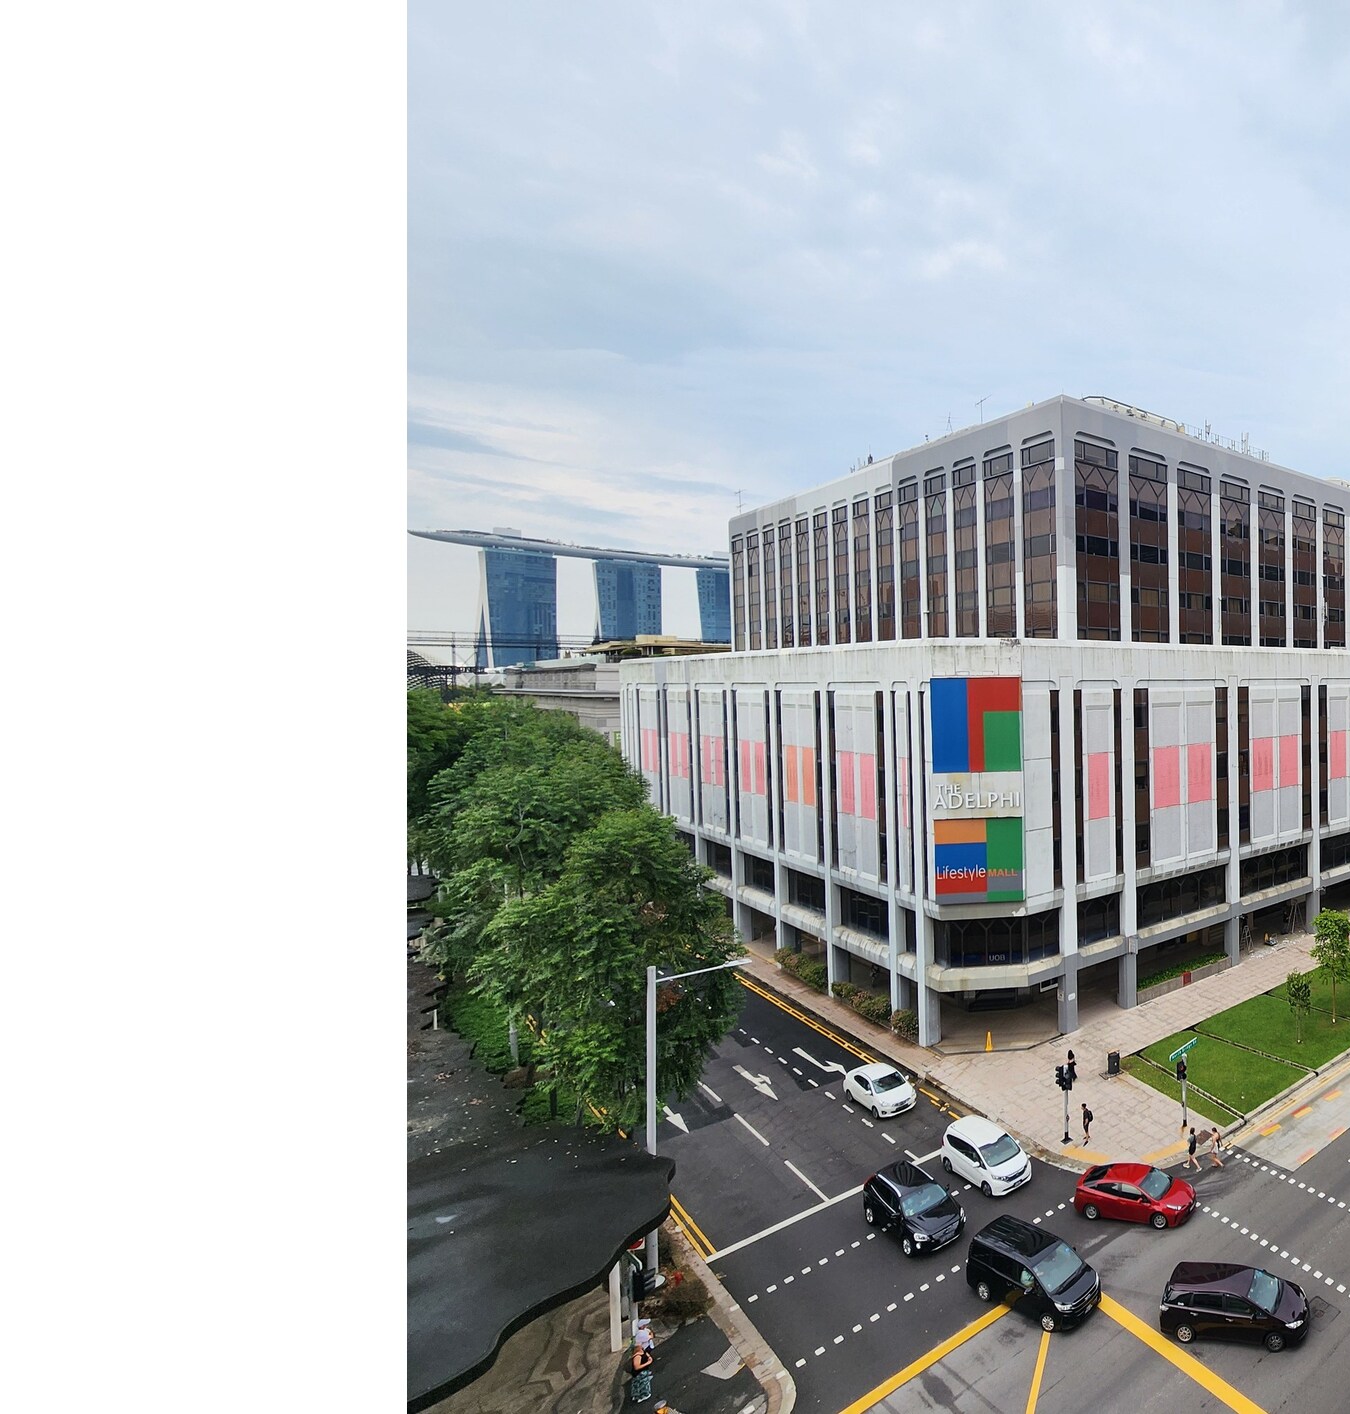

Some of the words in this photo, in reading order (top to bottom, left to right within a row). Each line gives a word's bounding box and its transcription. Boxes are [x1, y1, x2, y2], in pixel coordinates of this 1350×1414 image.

[936, 784, 961, 794] THE
[933, 792, 1020, 809] ADELPHI
[937, 864, 986, 881] Lifestyle
[987, 868, 1018, 877] MALL
[989, 954, 1006, 962] UOB
